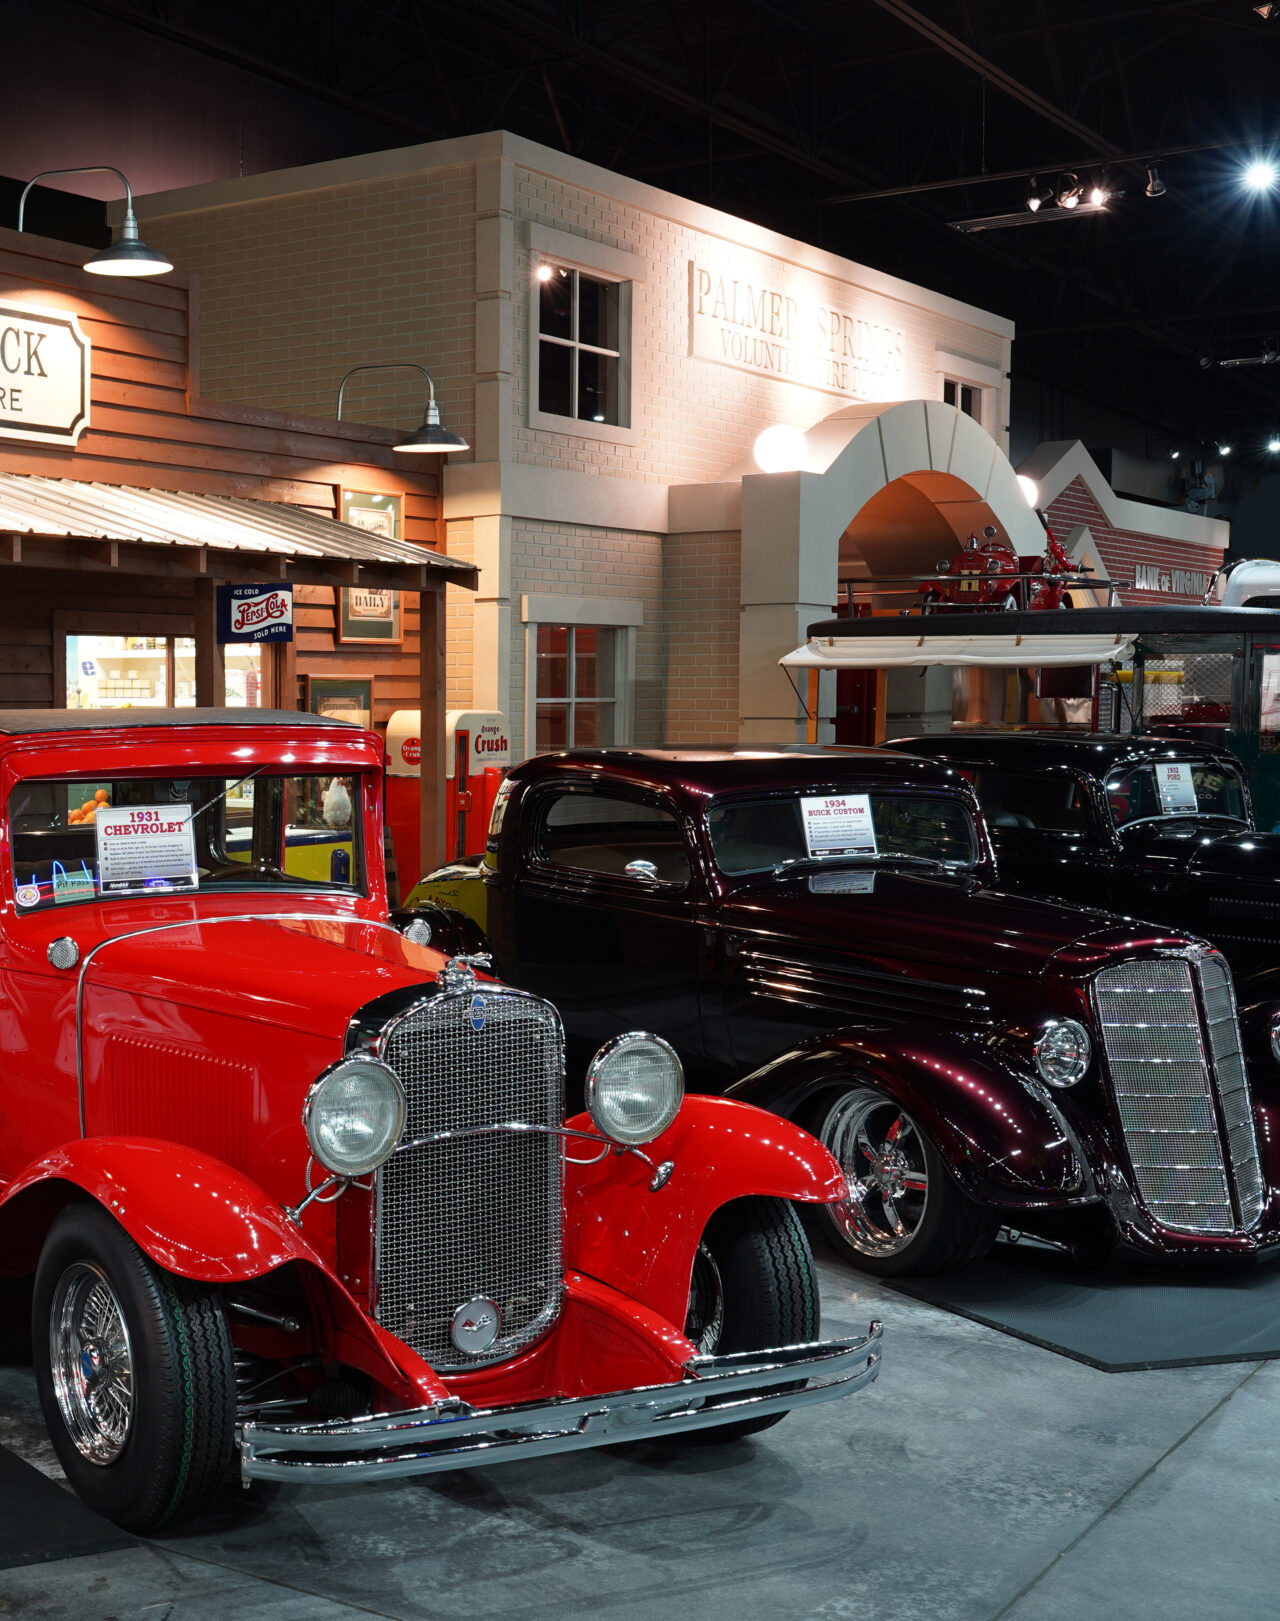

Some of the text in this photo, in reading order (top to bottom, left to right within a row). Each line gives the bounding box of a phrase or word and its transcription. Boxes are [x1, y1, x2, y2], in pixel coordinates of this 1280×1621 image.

[697, 268, 904, 372] PALMER SPRINS
[720, 328, 810, 384] VOLUNTE
[1135, 564, 1160, 591] BANK
[355, 595, 385, 608] DAILY
[253, 630, 269, 640] SOLD
[402, 745, 421, 753] Orang
[475, 734, 508, 754] Crush
[824, 800, 846, 808] 1934
[130, 811, 160, 822] 1931
[104, 822, 184, 836] CHEVROLET
